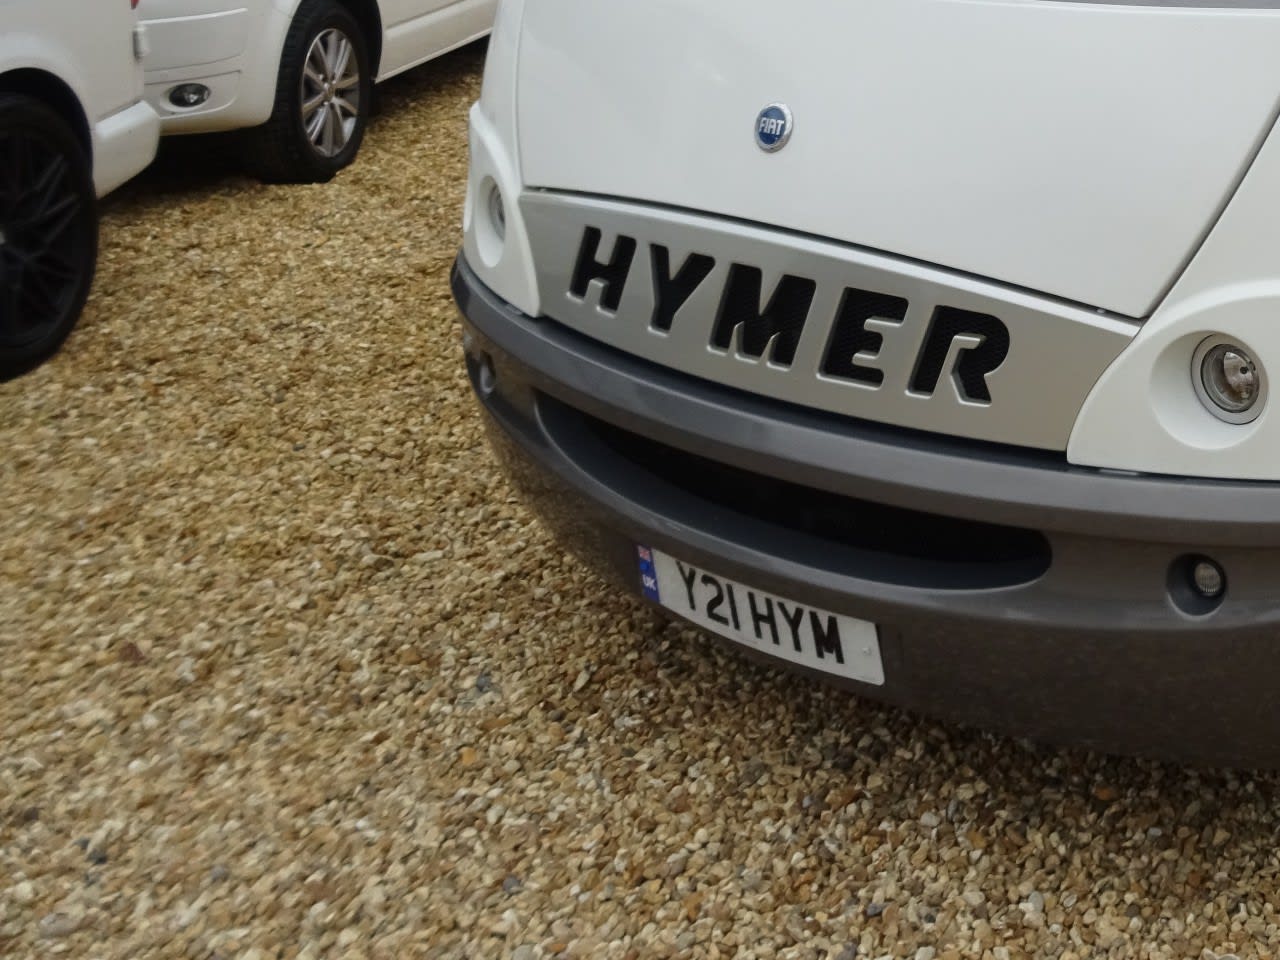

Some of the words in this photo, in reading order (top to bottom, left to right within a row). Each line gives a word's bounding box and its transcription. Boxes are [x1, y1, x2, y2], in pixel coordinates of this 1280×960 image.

[759, 117, 785, 136] FIAT
[566, 224, 1011, 407] HYMER
[675, 560, 741, 631] Y21
[747, 591, 845, 665] HYM
